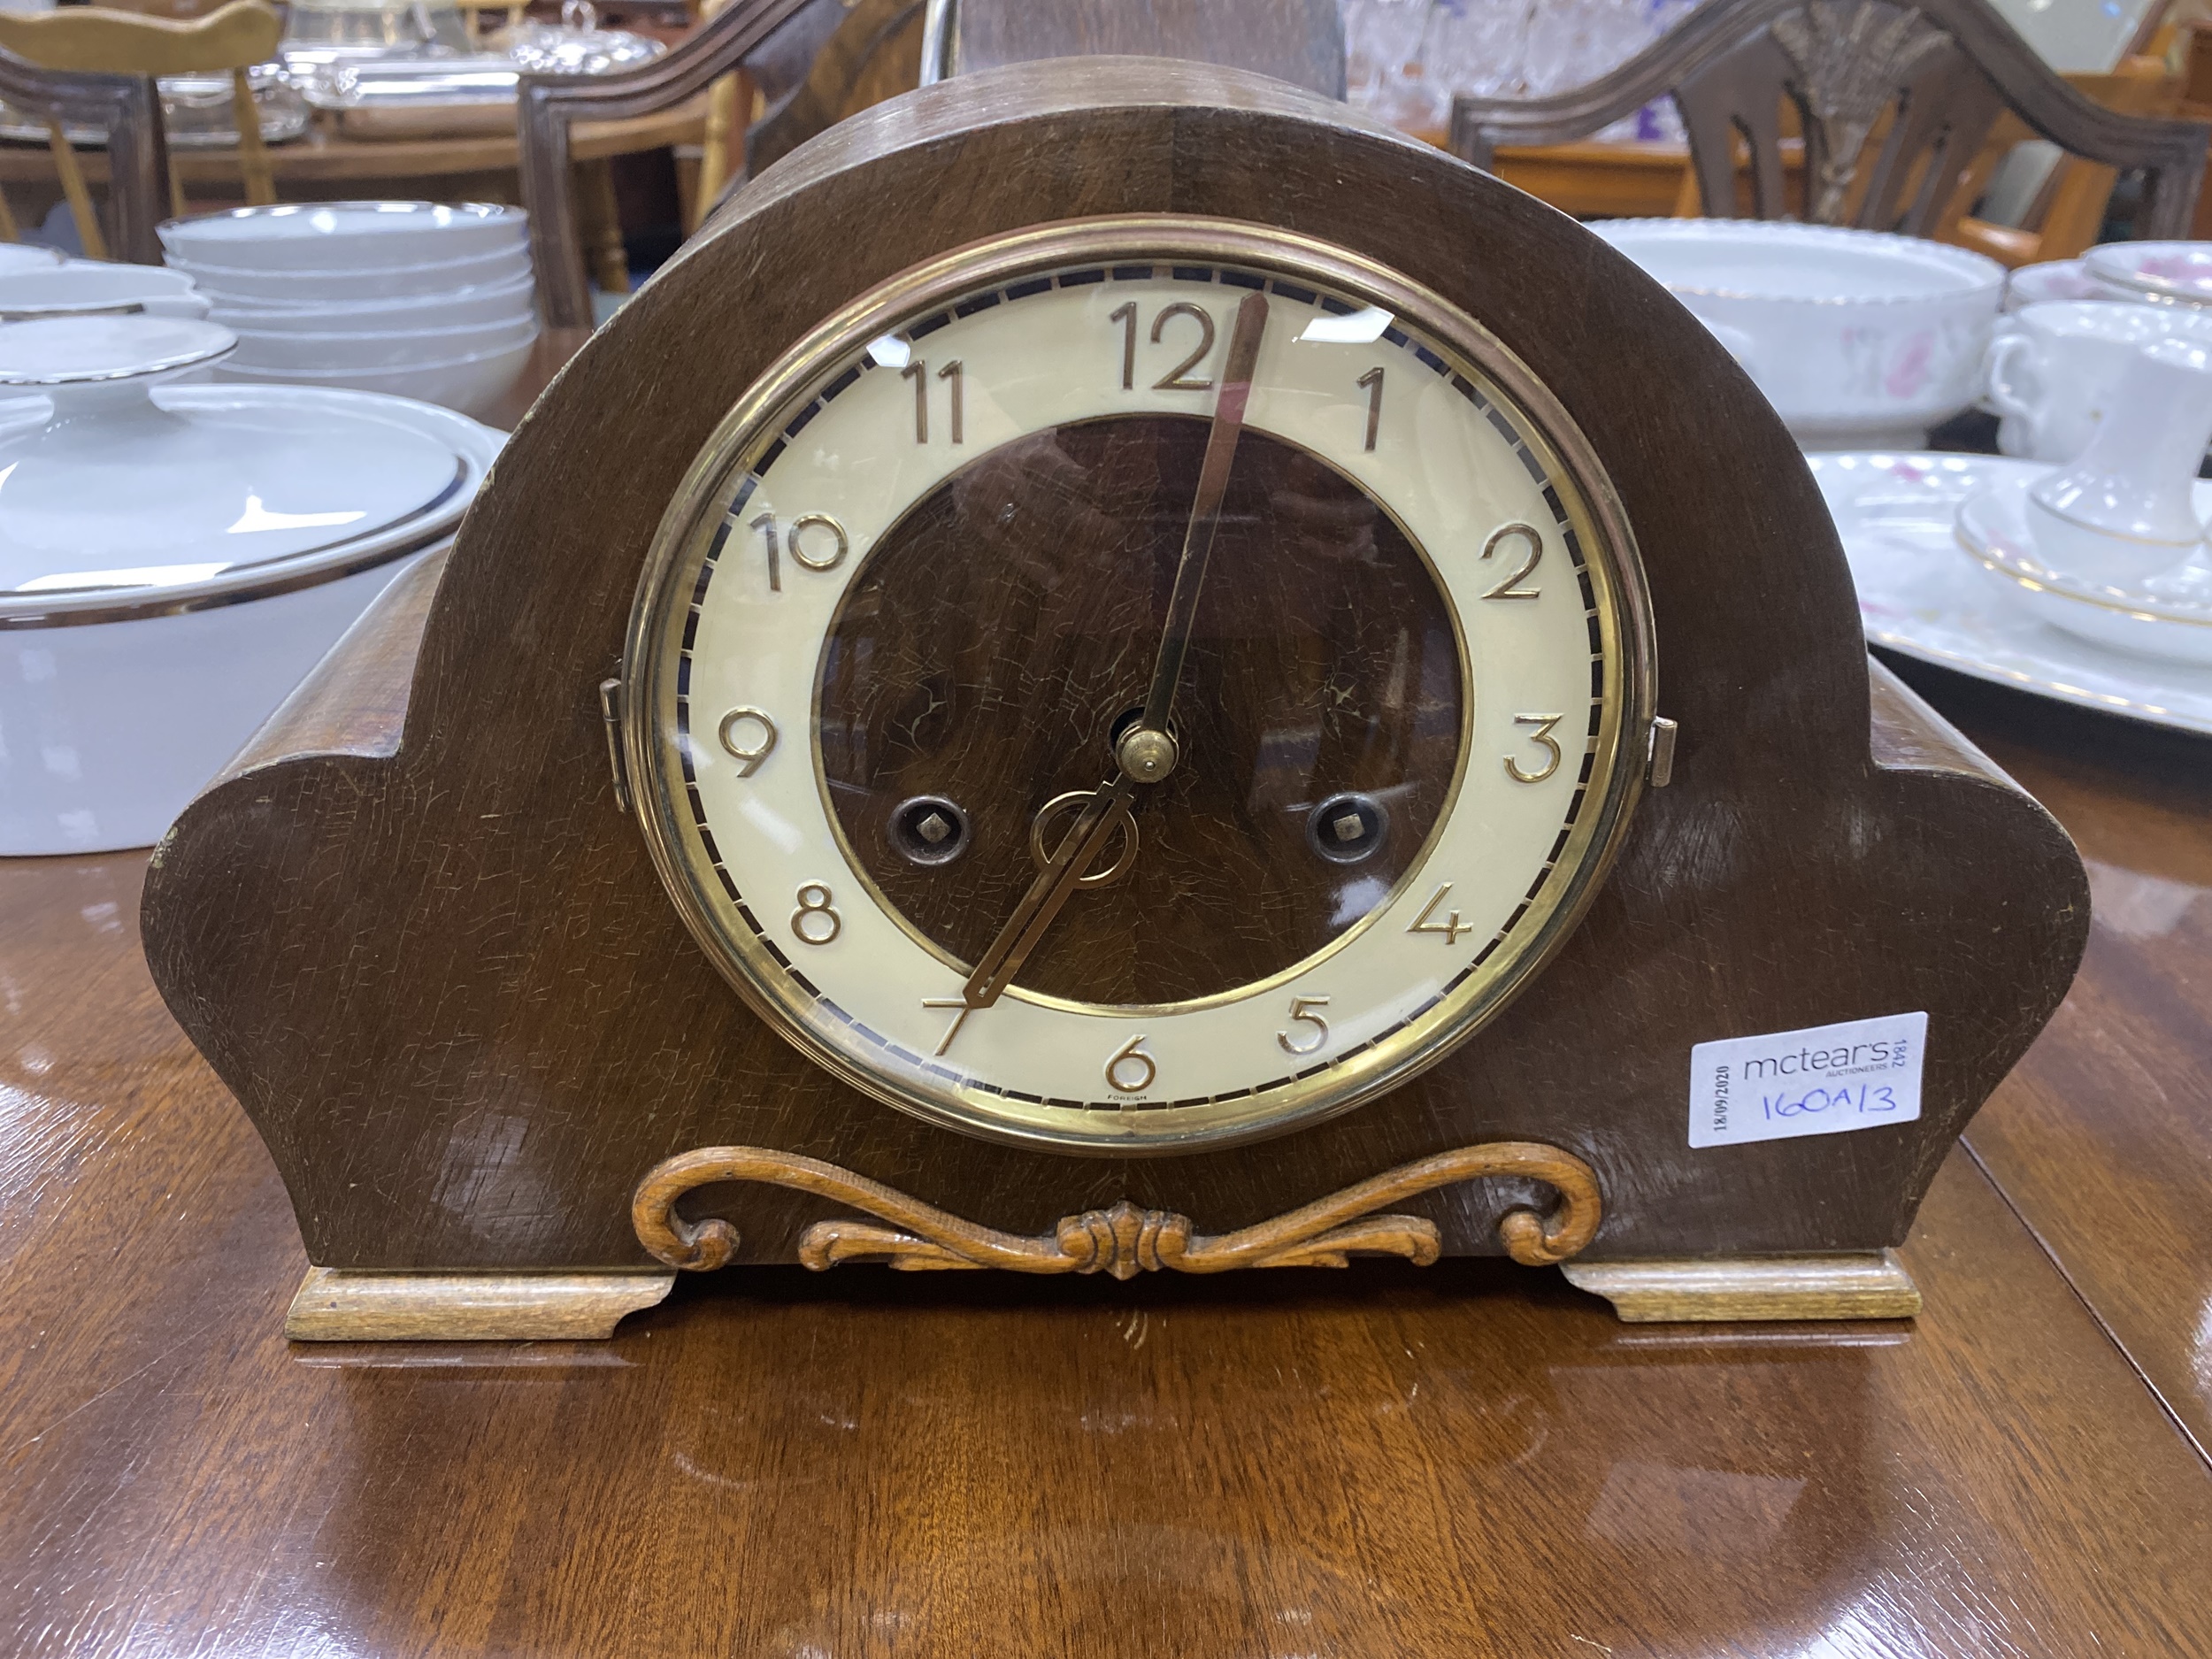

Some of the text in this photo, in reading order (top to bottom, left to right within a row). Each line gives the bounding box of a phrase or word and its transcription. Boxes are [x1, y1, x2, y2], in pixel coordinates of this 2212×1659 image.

[1110, 301, 1216, 390] 12
[900, 358, 964, 445] 11
[1356, 365, 1386, 452] 1
[749, 512, 849, 592] 10
[1481, 522, 1544, 600] 2
[718, 706, 779, 779] 9
[1503, 712, 1565, 783] 3
[790, 883, 841, 946] 8
[1405, 882, 1472, 945] 4
[921, 997, 979, 1056] 7
[1277, 995, 1331, 1056] 5
[1892, 1039, 1908, 1069] 1842
[1104, 1033, 1156, 1093] 6
[1825, 1062, 1887, 1079] AUCTIONEERS
[1713, 1065, 1730, 1133] 18/09/2020
